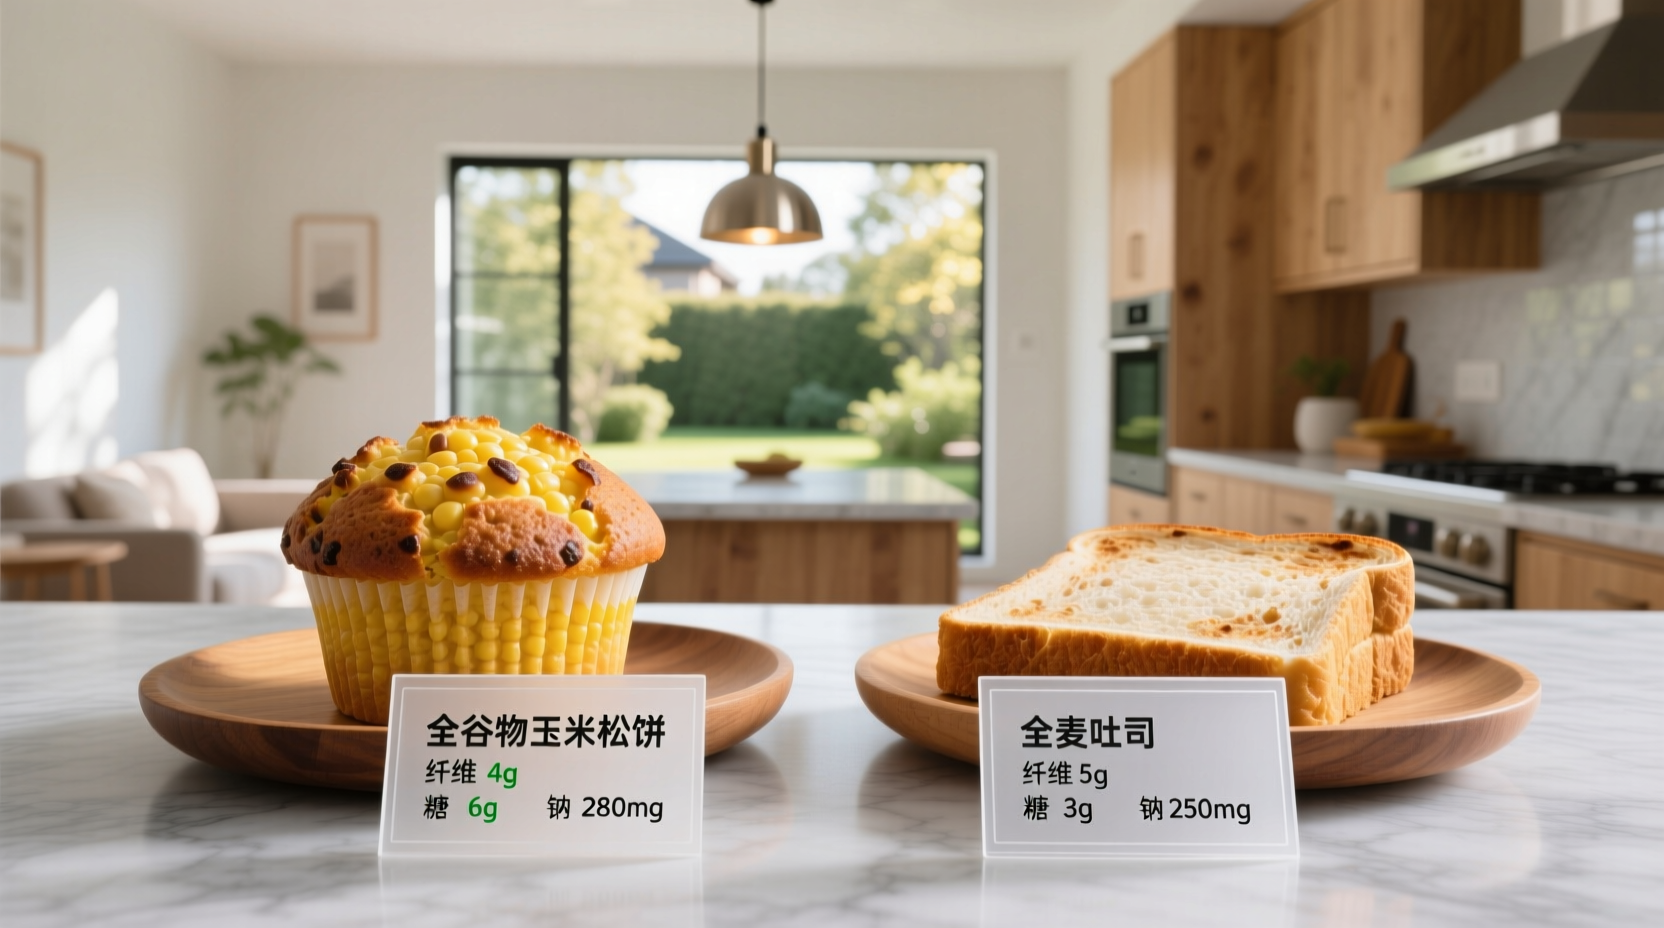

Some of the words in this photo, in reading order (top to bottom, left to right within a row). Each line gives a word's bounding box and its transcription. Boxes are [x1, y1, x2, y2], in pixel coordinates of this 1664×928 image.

[426, 713, 666, 749] 全谷物玉米松饼
[1020, 714, 1155, 750] 全麦吐司
[425, 758, 477, 785] 纤维
[486, 762, 518, 789] 4g
[1022, 760, 1074, 786] 纤维
[1079, 763, 1108, 790] 5g
[423, 794, 449, 820] 糖
[467, 796, 498, 824] 6g
[546, 794, 571, 820] 钠
[581, 796, 664, 824] 280mg
[1023, 794, 1050, 821] 糖
[1063, 797, 1093, 824] 3g
[1139, 795, 1164, 821] 钠
[1169, 797, 1251, 825] 250mg
